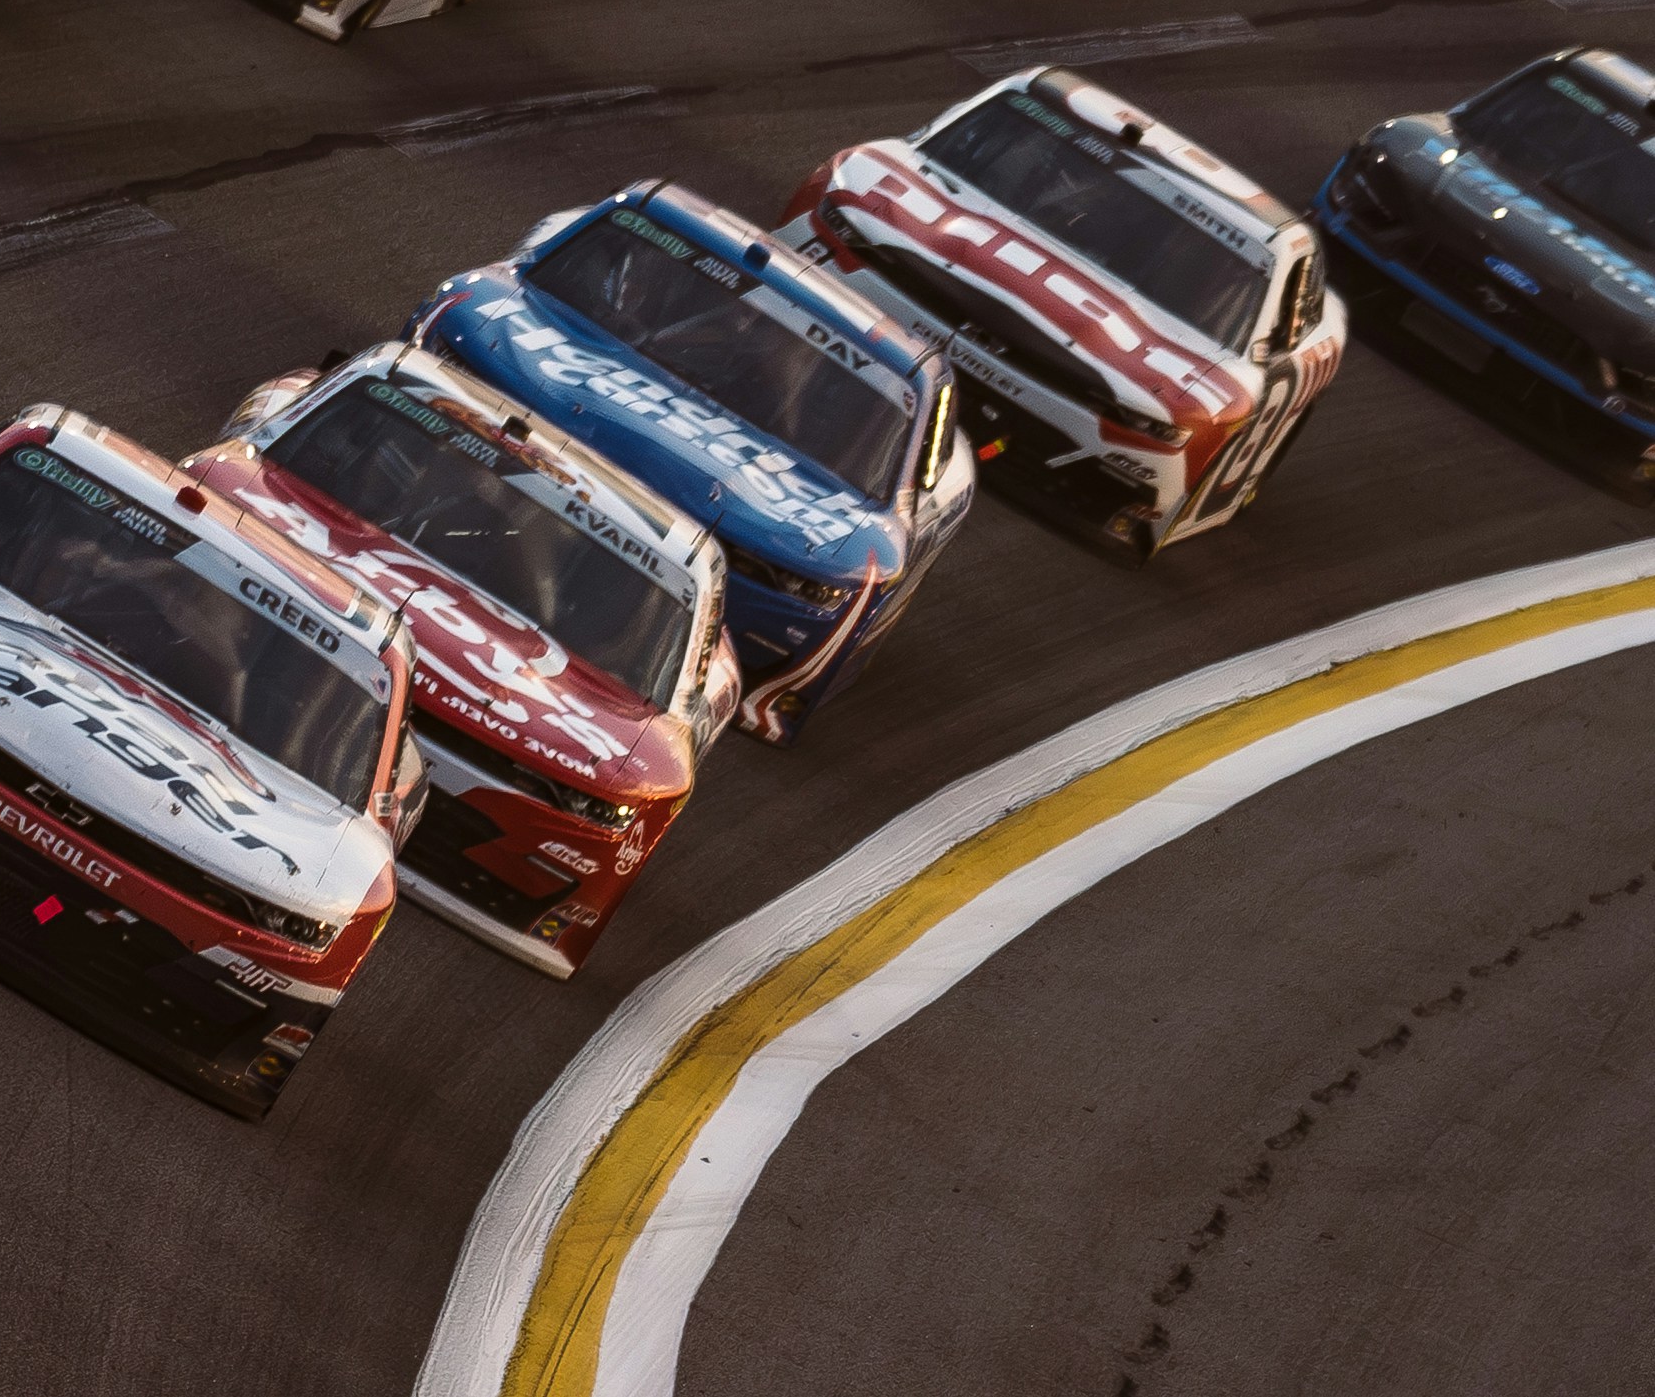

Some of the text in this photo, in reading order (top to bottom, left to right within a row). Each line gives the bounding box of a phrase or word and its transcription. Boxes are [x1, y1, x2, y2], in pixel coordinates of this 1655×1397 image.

[1170, 193, 1246, 248] SMITH
[805, 324, 870, 373] DAY
[476, 299, 880, 528] Hendrick
[539, 356, 849, 547] Cars.com
[15, 443, 117, 516] O'Reilly
[562, 502, 668, 578] KVAPIL
[236, 485, 630, 764] Arby's
[237, 577, 341, 654] CREED
